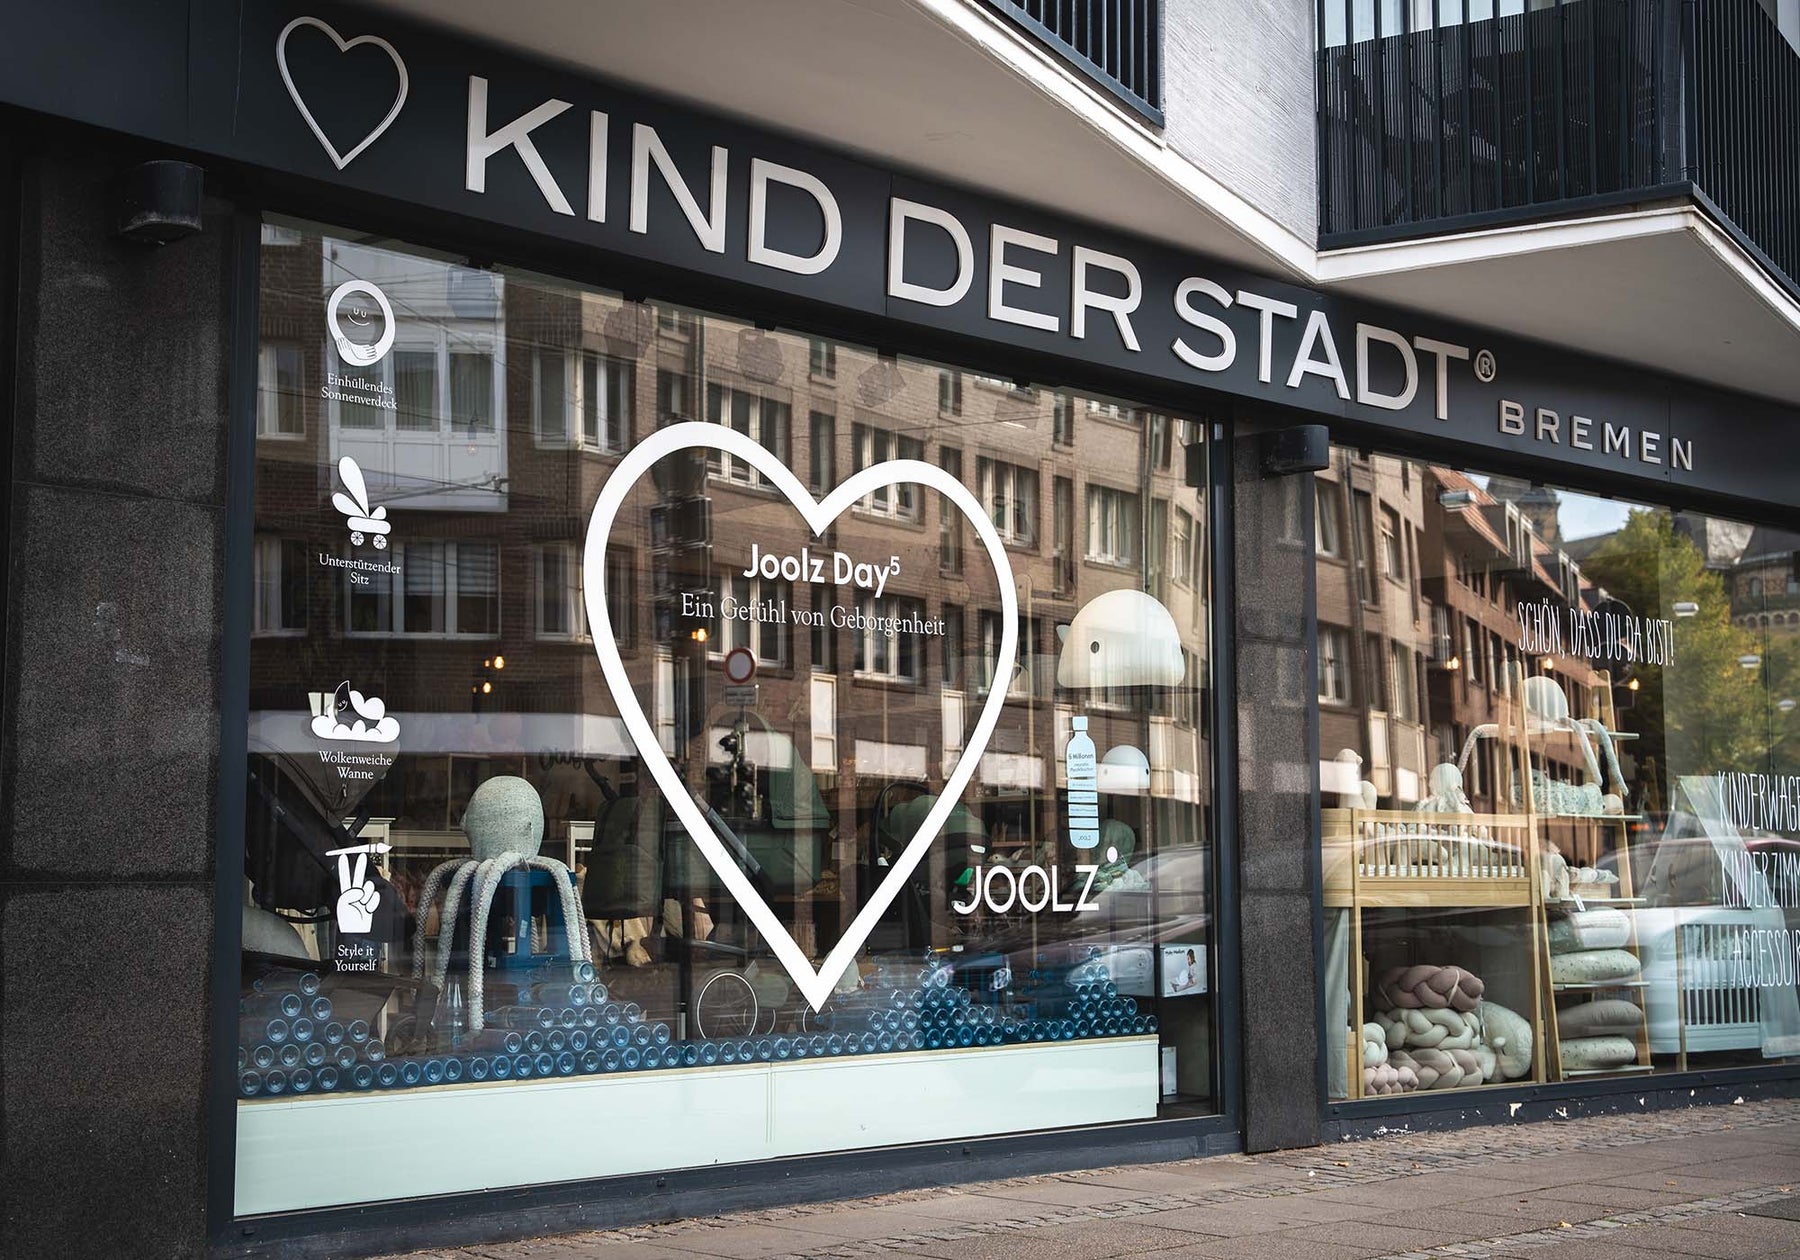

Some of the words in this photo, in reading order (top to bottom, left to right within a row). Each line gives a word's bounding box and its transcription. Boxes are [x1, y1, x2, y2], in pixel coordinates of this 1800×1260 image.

[466, 75, 842, 275] KIND
[888, 196, 1141, 352] DER
[327, 372, 393, 395] Einhüllendes
[321, 385, 398, 410] Sonnenverdeck
[1499, 399, 1693, 471] BREMEN
[319, 553, 401, 575] Unterstützender
[743, 544, 825, 583] Joolz
[350, 571, 370, 585] Sitz
[681, 592, 714, 619] Ein
[721, 596, 786, 624] Gefühl
[791, 609, 824, 627] von
[830, 605, 945, 637] Geborgenheit
[1518, 597, 1566, 660] SCHÖN,
[1570, 607, 1601, 659] DASS
[1605, 612, 1622, 661] DU
[1626, 616, 1643, 662] DA
[1645, 617, 1675, 667] BIST!
[319, 750, 392, 766] Wolkenweiche
[337, 766, 374, 780] Wanne
[953, 864, 1099, 915] JOOLZ
[338, 944, 364, 960] Style
[366, 945, 374, 957] it
[335, 958, 377, 972] Yourself
